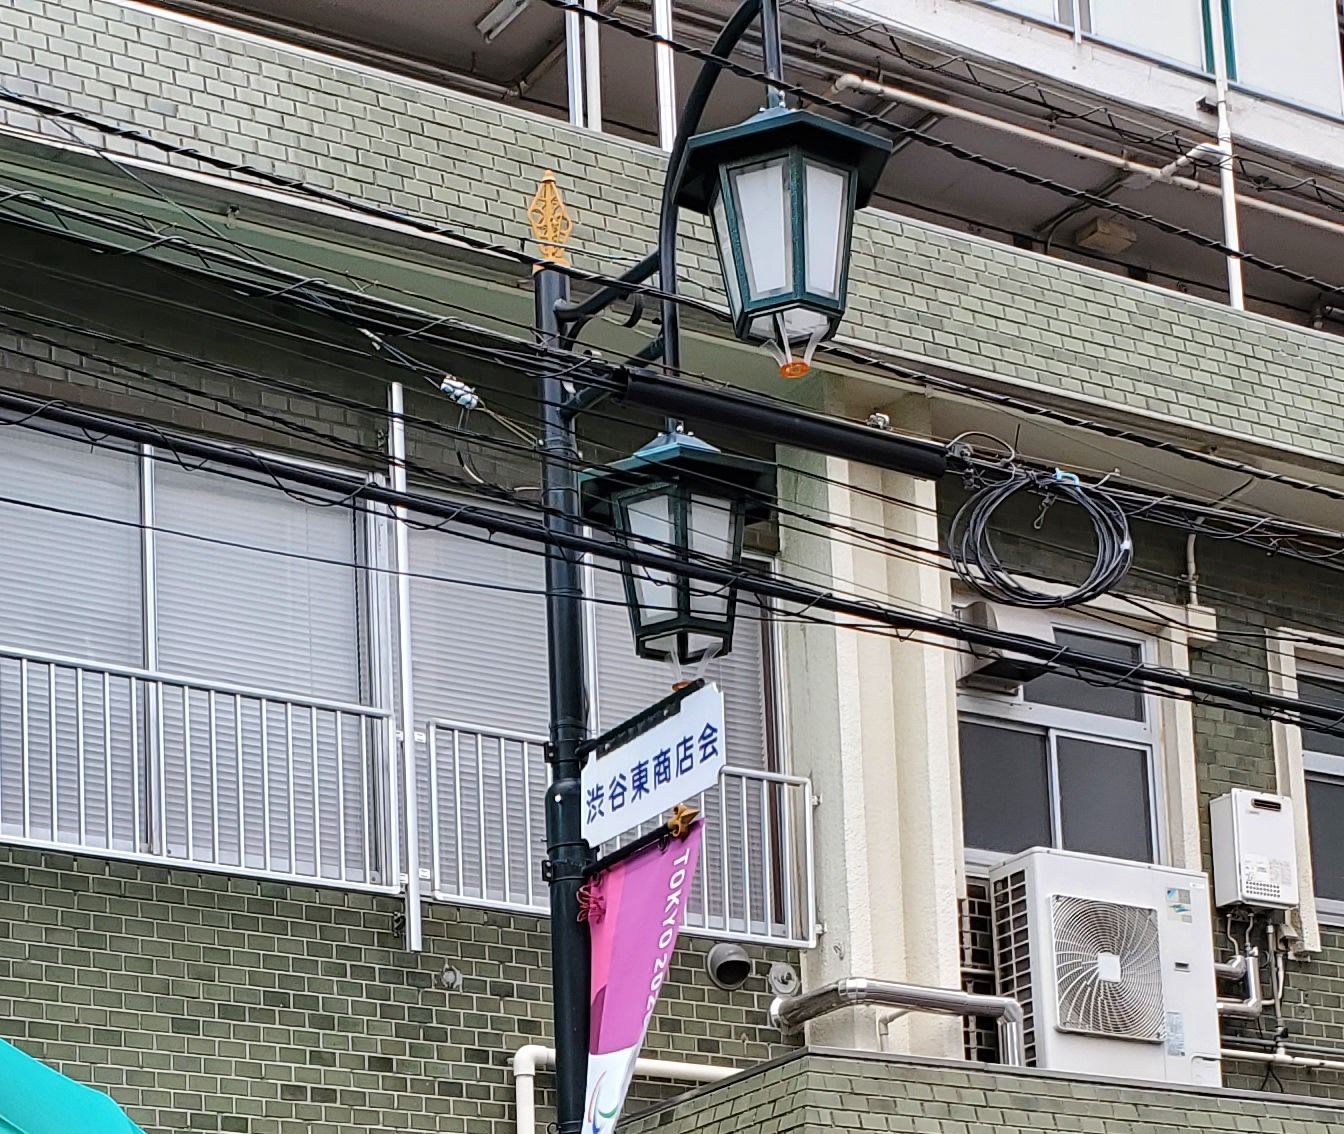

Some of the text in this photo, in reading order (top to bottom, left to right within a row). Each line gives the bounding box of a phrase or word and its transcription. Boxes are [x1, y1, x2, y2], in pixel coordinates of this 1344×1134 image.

[585, 722, 719, 825] 渋谷東商店会
[657, 847, 690, 949] TOKYO
